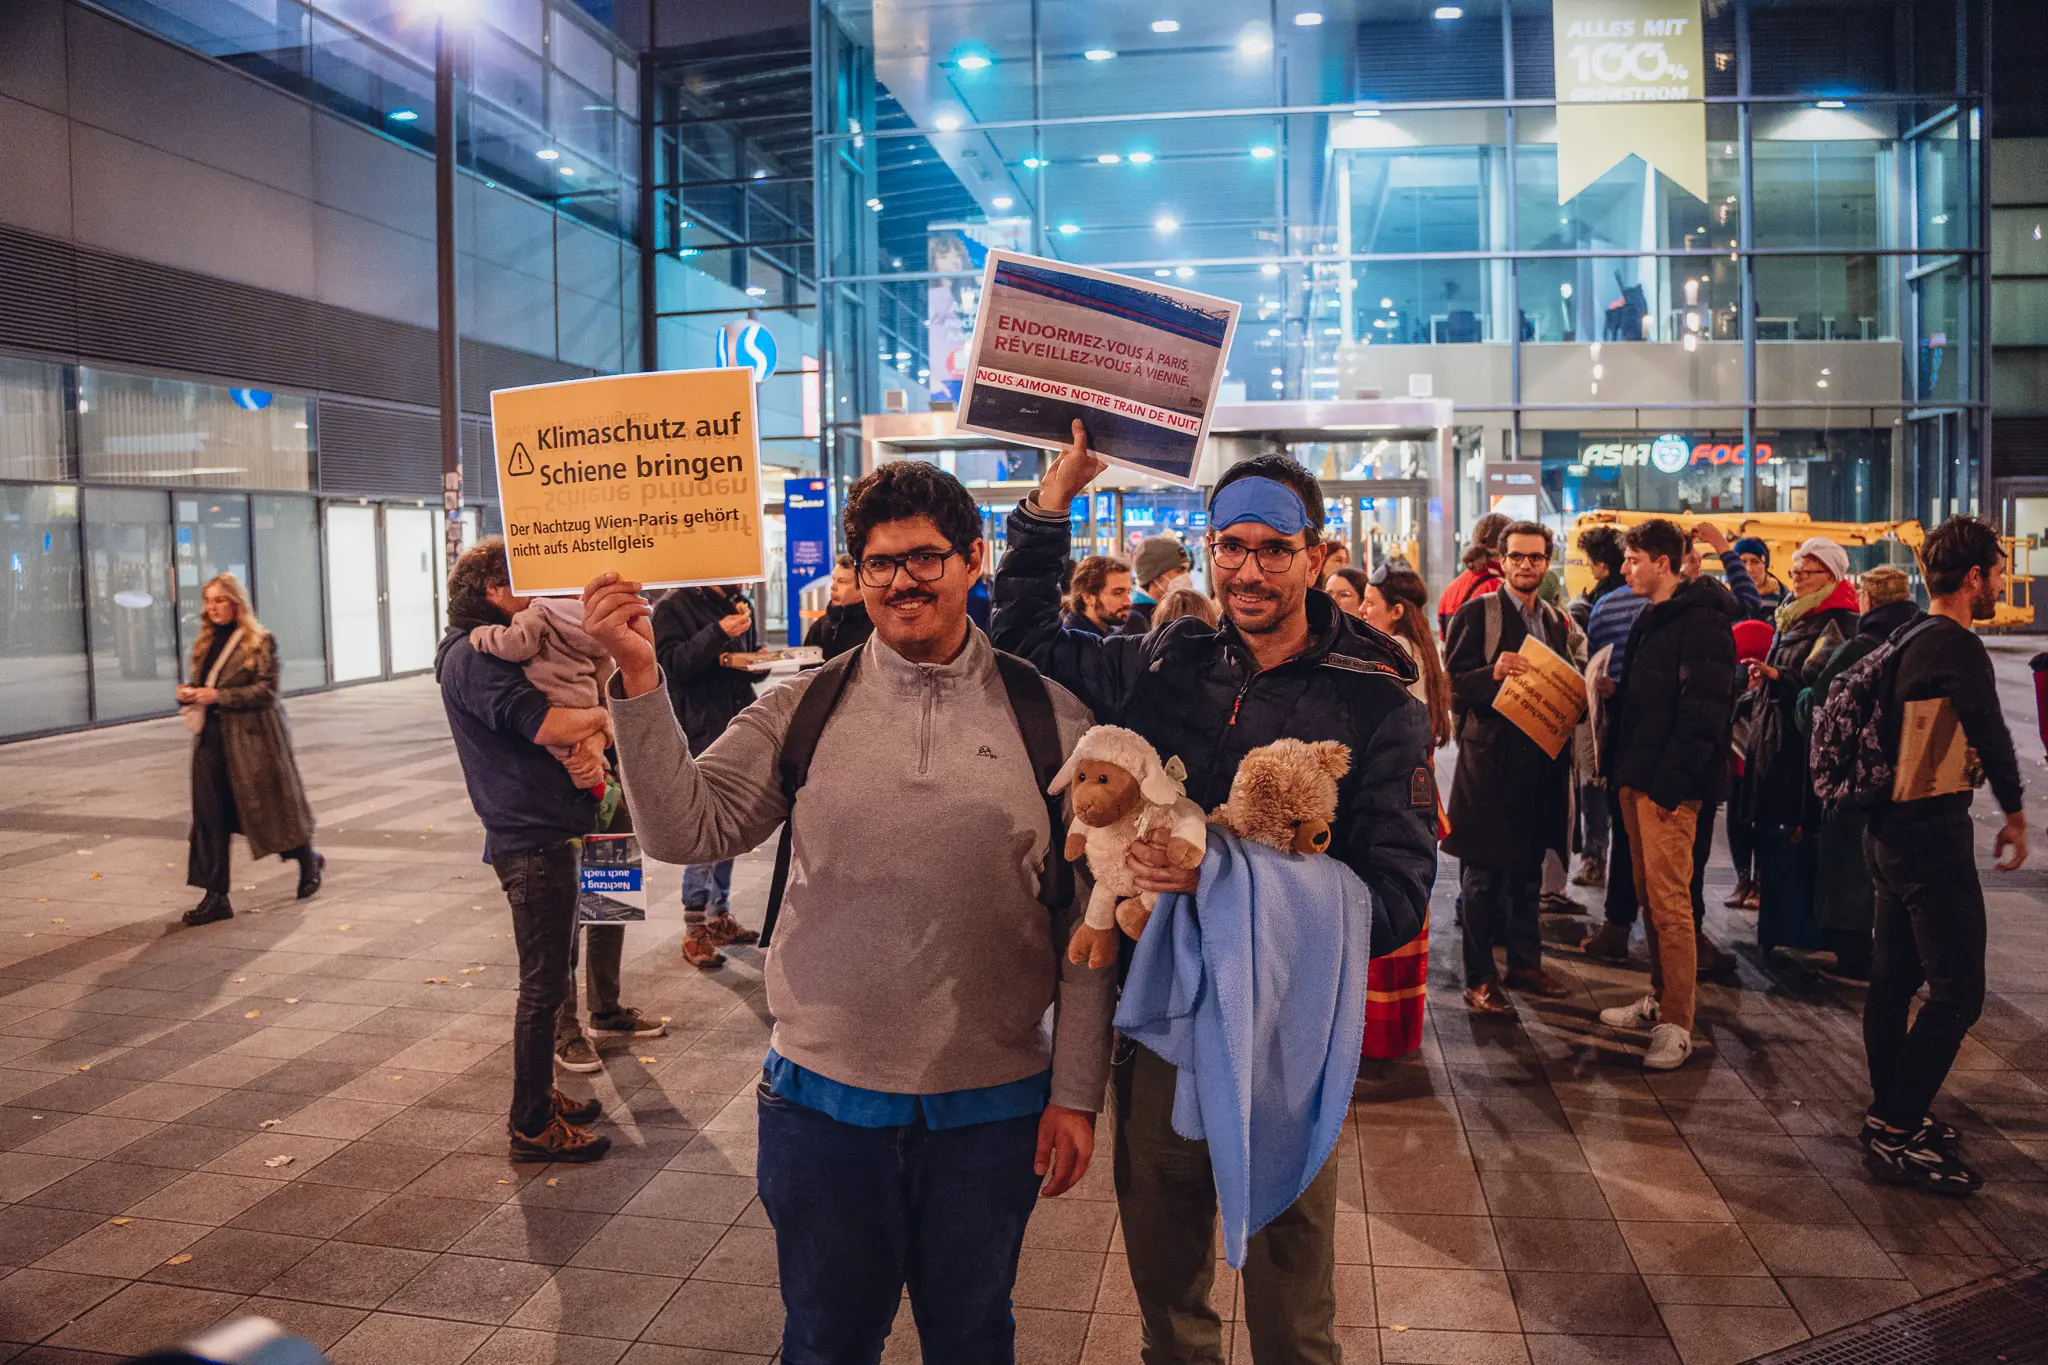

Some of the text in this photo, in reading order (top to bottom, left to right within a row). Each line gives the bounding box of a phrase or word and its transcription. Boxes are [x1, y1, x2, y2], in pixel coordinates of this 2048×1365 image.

[1567, 19, 1688, 38] ALLES MIT
[1567, 42, 1689, 82] 100%
[998, 315, 1190, 373] ENDORMEZ-VOUS À PARIS,
[994, 335, 1132, 374] RÉVEILLEZ-VOUS
[1133, 362, 1142, 377] À
[1147, 367, 1190, 387] VIENNE.
[977, 370, 1198, 431] NOUS AIMONS NOTRE TRAIN DE NUIT.
[537, 411, 741, 451] Klimaschutz auf
[540, 453, 743, 487] Schiene bringen
[1582, 443, 1652, 467] ASIA
[510, 508, 740, 537] Der Nachtzug Wien-Paris gehört
[513, 535, 655, 557] nicht aufs Abstellgleis
[584, 869, 630, 878] auch nach
[588, 880, 631, 890] Nachtzug
